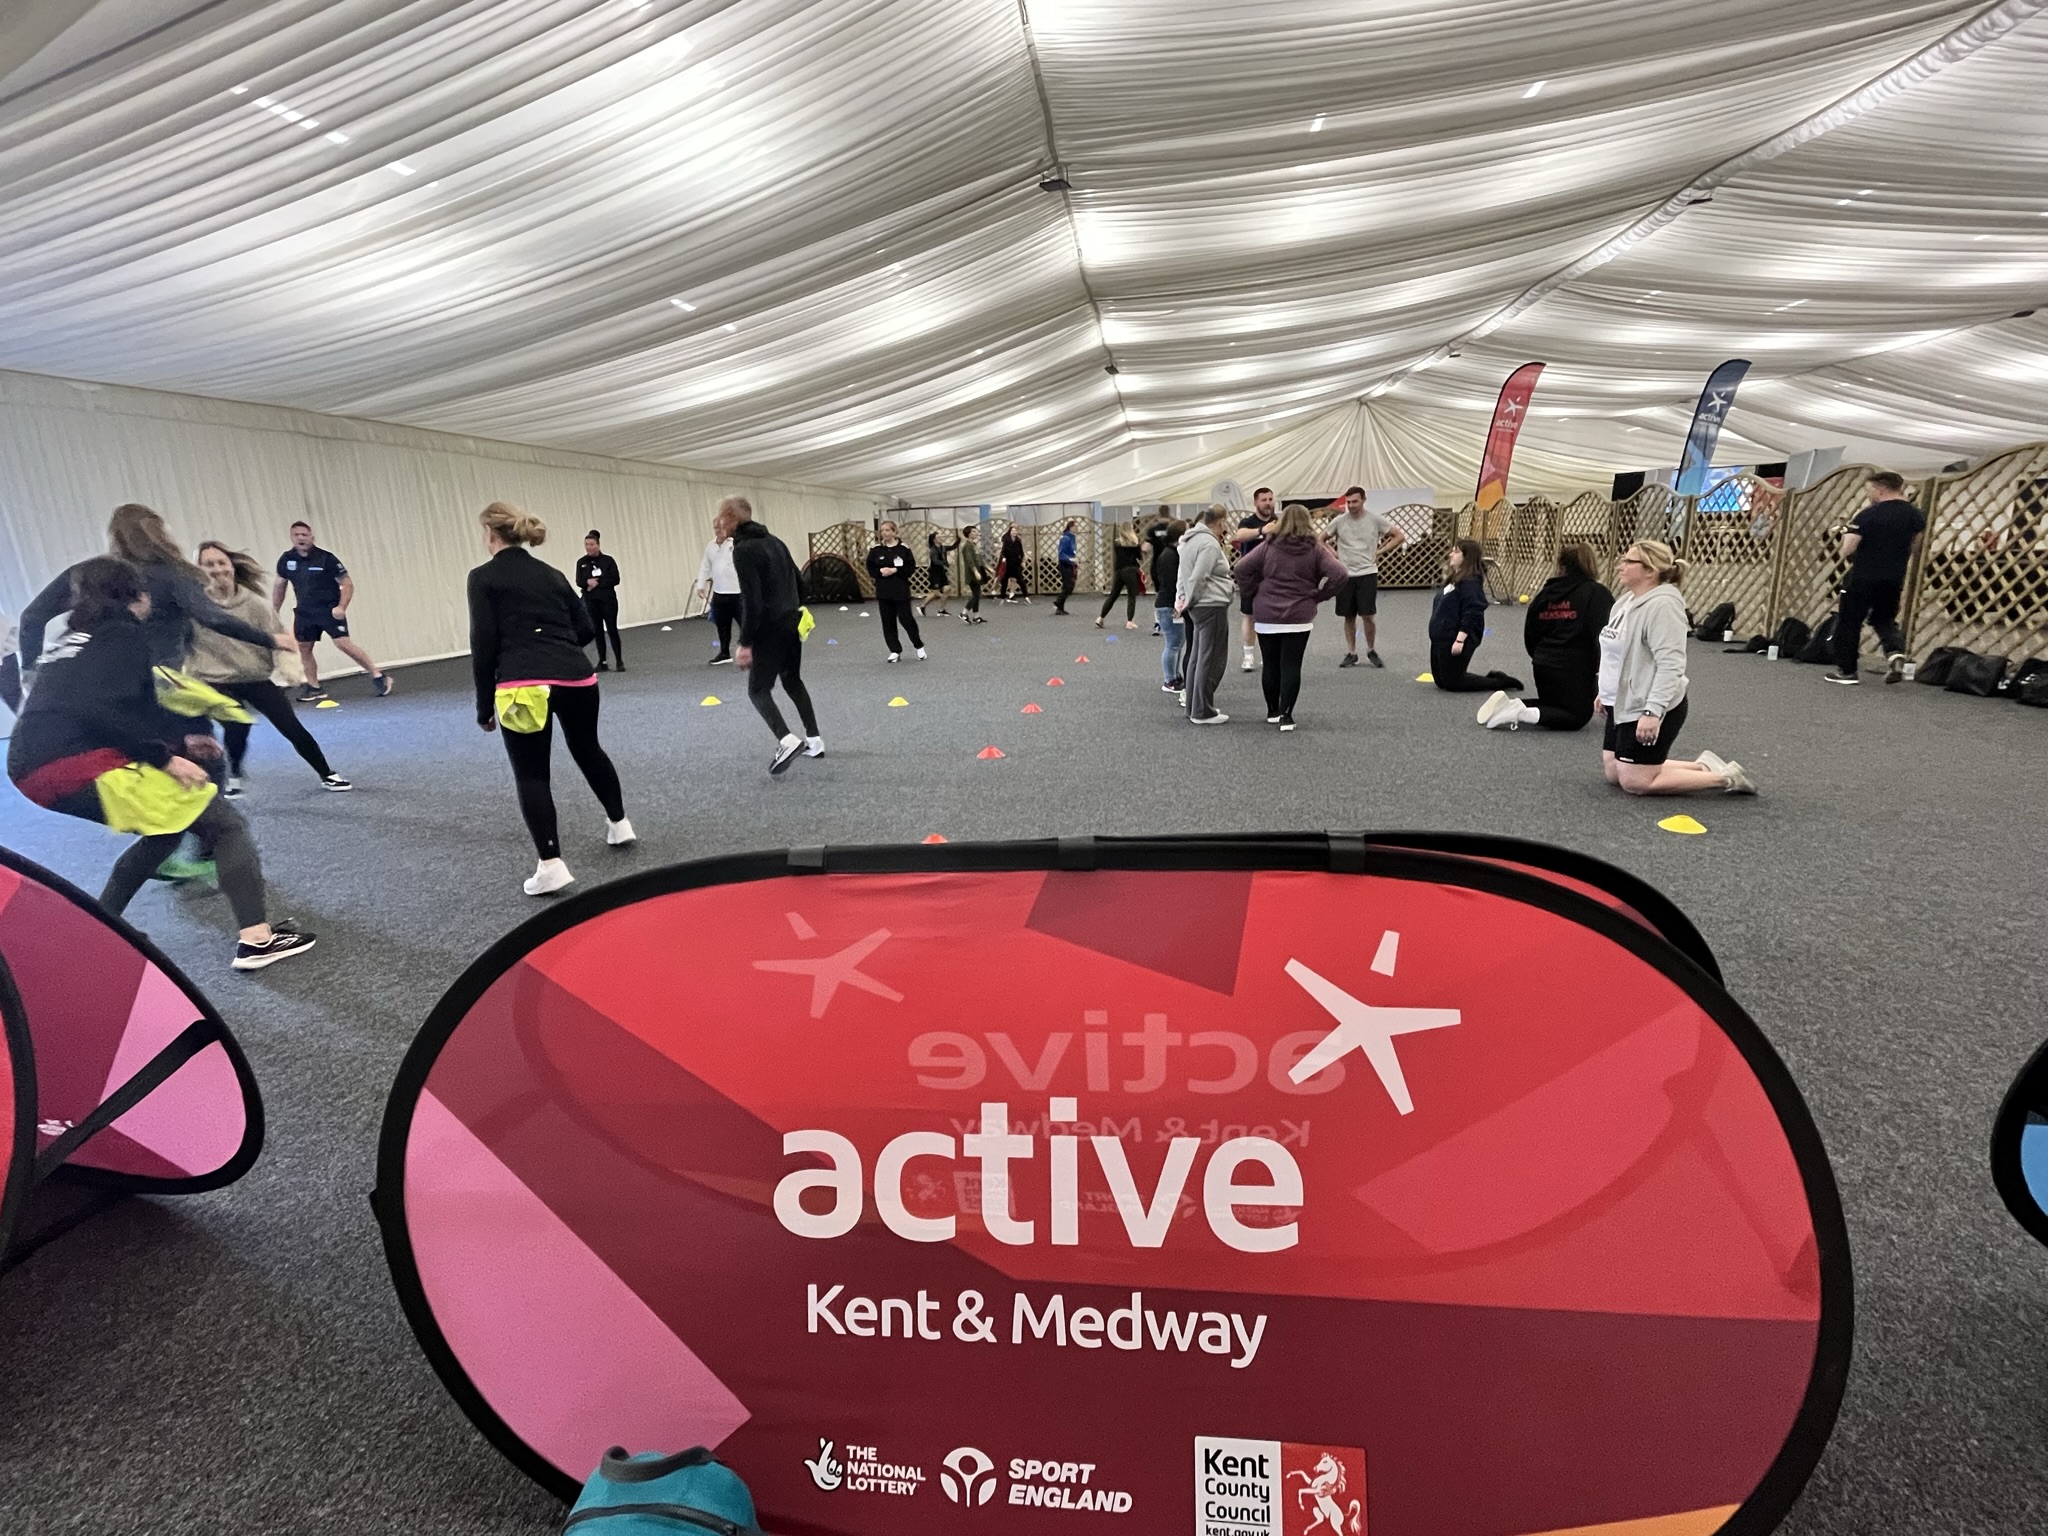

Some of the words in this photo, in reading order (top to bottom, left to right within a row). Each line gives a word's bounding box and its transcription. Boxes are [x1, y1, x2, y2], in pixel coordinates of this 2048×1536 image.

[773, 1096, 1305, 1253] active
[807, 1284, 942, 1340] Kent
[953, 1289, 997, 1344] &
[1010, 1292, 1268, 1369] Medway
[846, 1445, 878, 1461] THE
[1204, 1448, 1269, 1479] Kent
[847, 1461, 926, 1481] NATIONAL
[1008, 1458, 1096, 1484] SPORT
[847, 1476, 917, 1496] LOTTERY
[1008, 1483, 1133, 1513] ENGLAND
[1205, 1477, 1270, 1503] County
[1205, 1501, 1271, 1523] Council
[1205, 1524, 1270, 1536] kent.govuk
